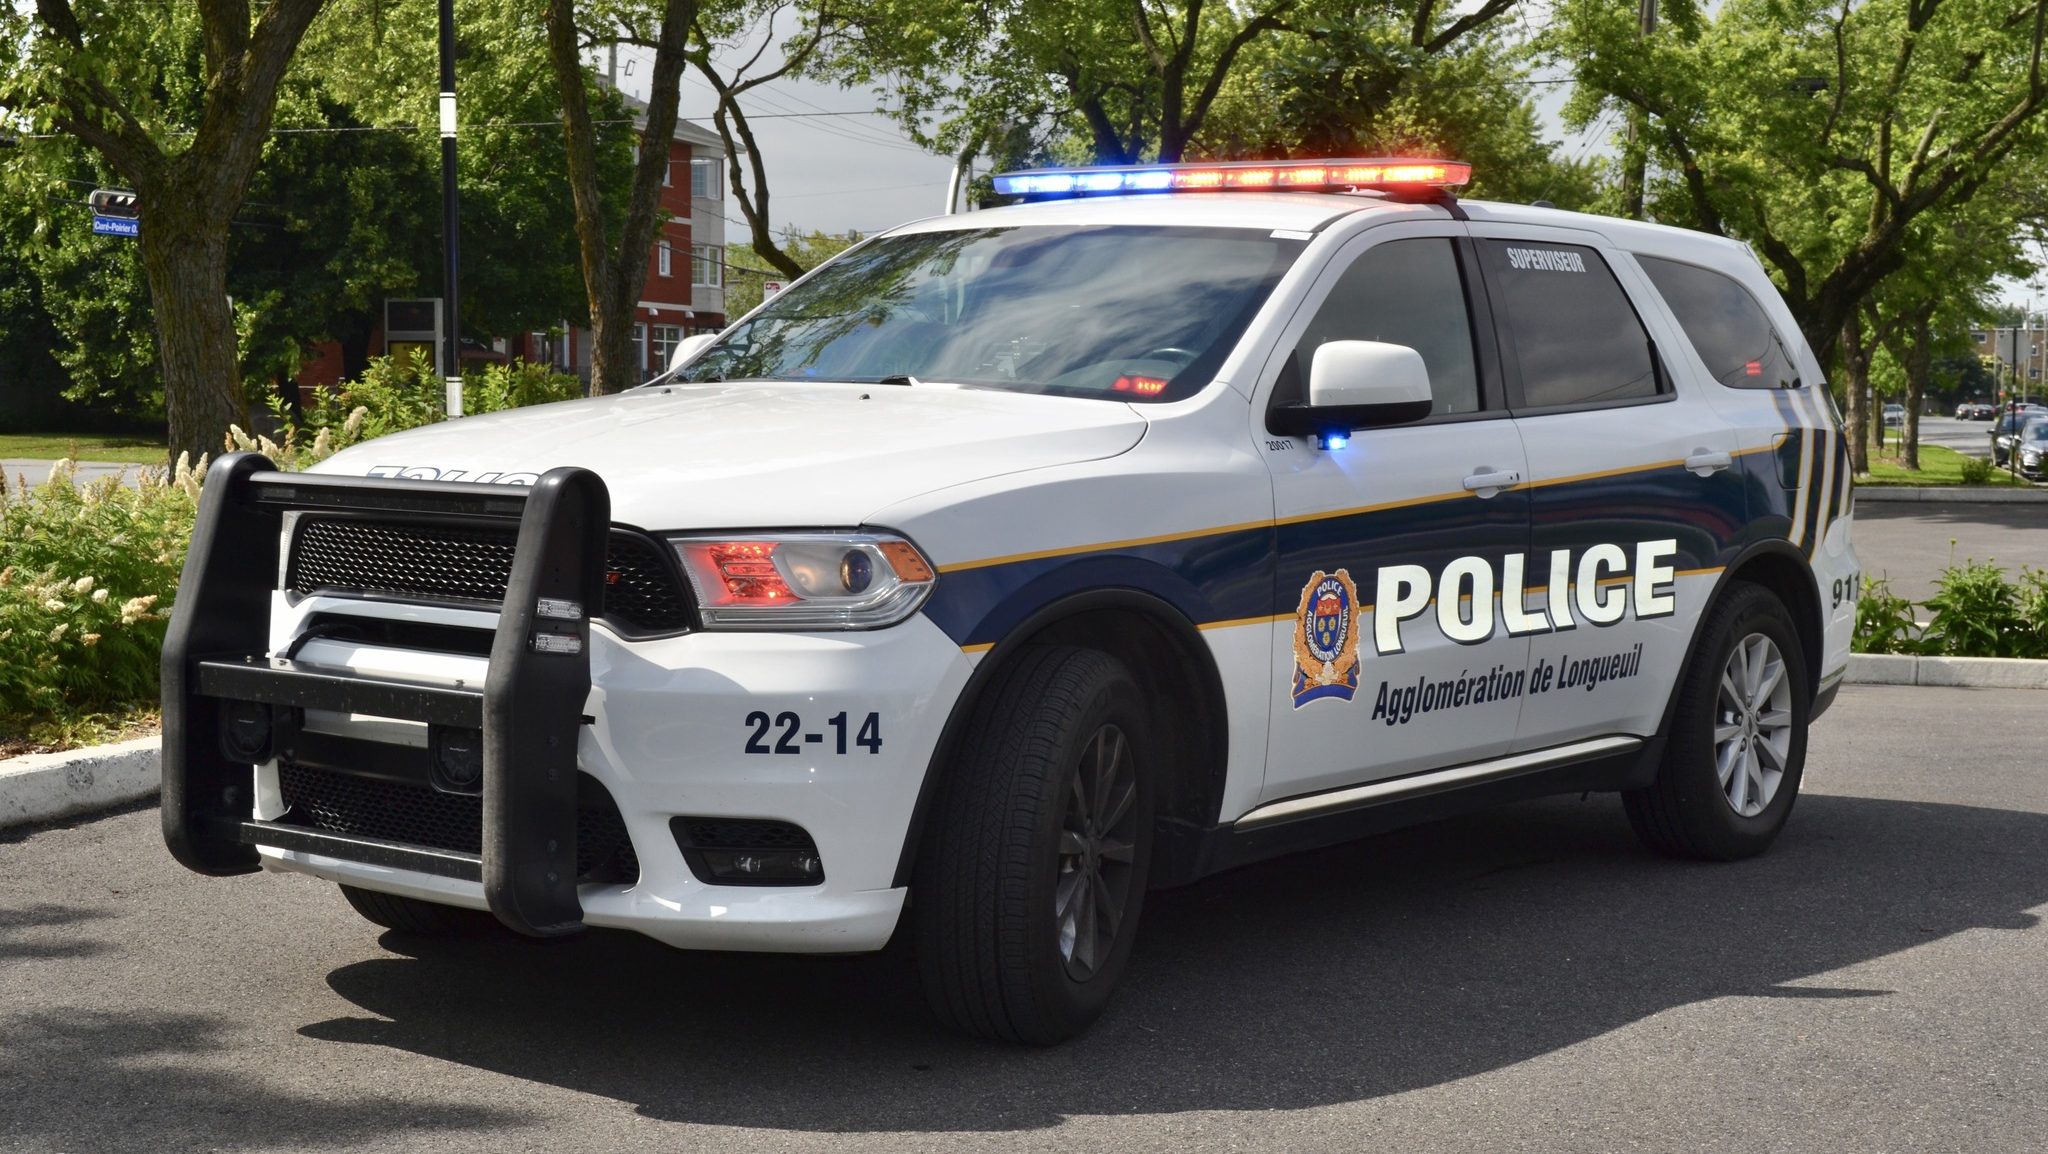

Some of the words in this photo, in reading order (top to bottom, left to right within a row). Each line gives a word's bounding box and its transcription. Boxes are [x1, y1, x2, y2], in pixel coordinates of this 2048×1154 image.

[1507, 247, 1586, 273] SUPERVISEUR
[1265, 440, 1294, 451] 20017
[1317, 580, 1343, 597] POLICE
[1373, 539, 1677, 656] POLICE
[1333, 605, 1349, 655] LONGUEUIL
[1371, 664, 1525, 726] Agglomération
[1529, 658, 1552, 694] de
[1557, 643, 1643, 692] Longueuil
[745, 711, 883, 754] 22-14
